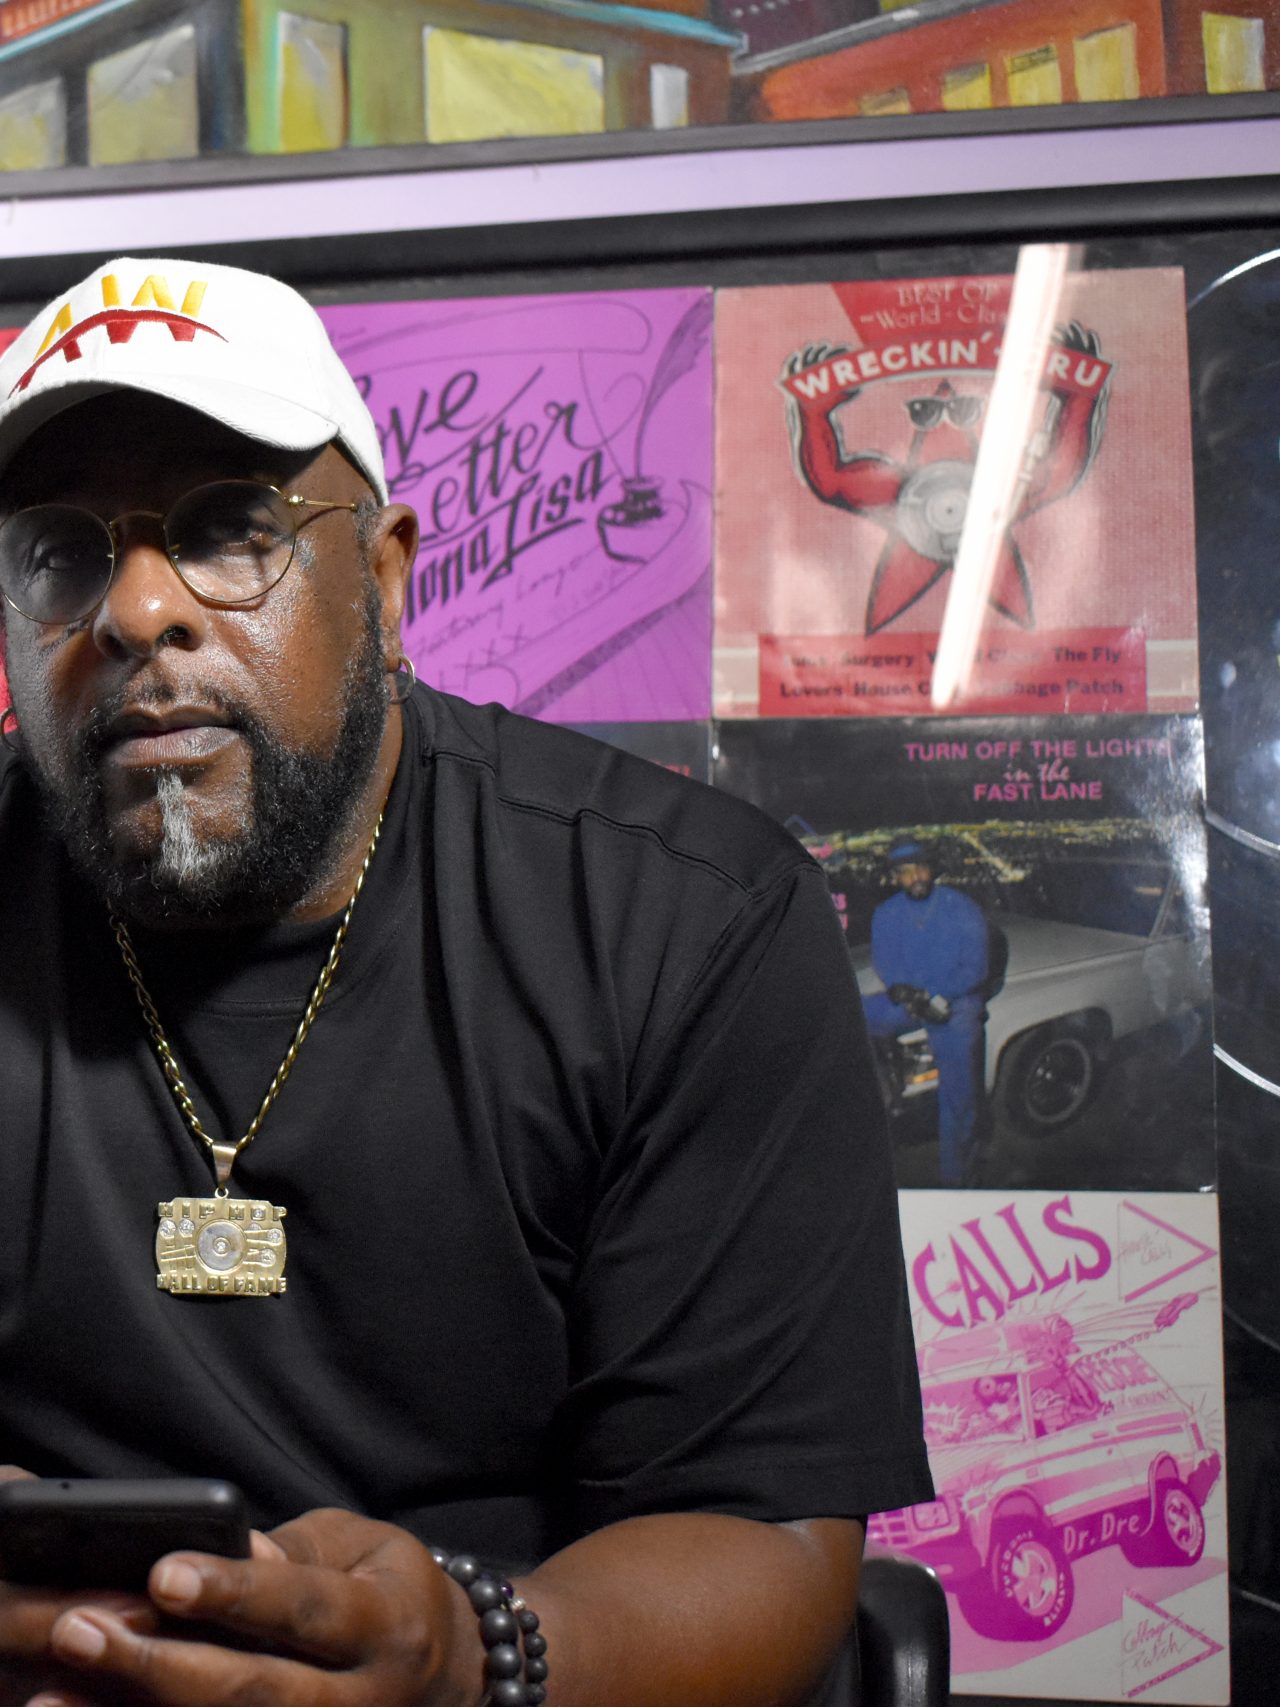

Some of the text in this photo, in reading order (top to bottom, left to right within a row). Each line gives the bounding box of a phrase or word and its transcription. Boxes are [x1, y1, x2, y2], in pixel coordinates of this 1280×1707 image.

[898, 282, 955, 305] BEST
[793, 330, 1103, 401] WRECKIN' RU
[482, 450, 608, 591] Lisa
[1053, 647, 1089, 662] The
[1092, 647, 1122, 666] Fly
[853, 679, 910, 698] House
[1066, 678, 1124, 696] Patch
[904, 737, 1173, 762] TURN OFF THE LIGHTS
[1003, 758, 1070, 783] in the
[974, 781, 1102, 802] FAST LANE
[911, 1194, 1112, 1329] CALLS
[207, 1275, 229, 1291] OF
[233, 1276, 287, 1293] FAME
[1063, 1512, 1141, 1555] Dr. Dre
